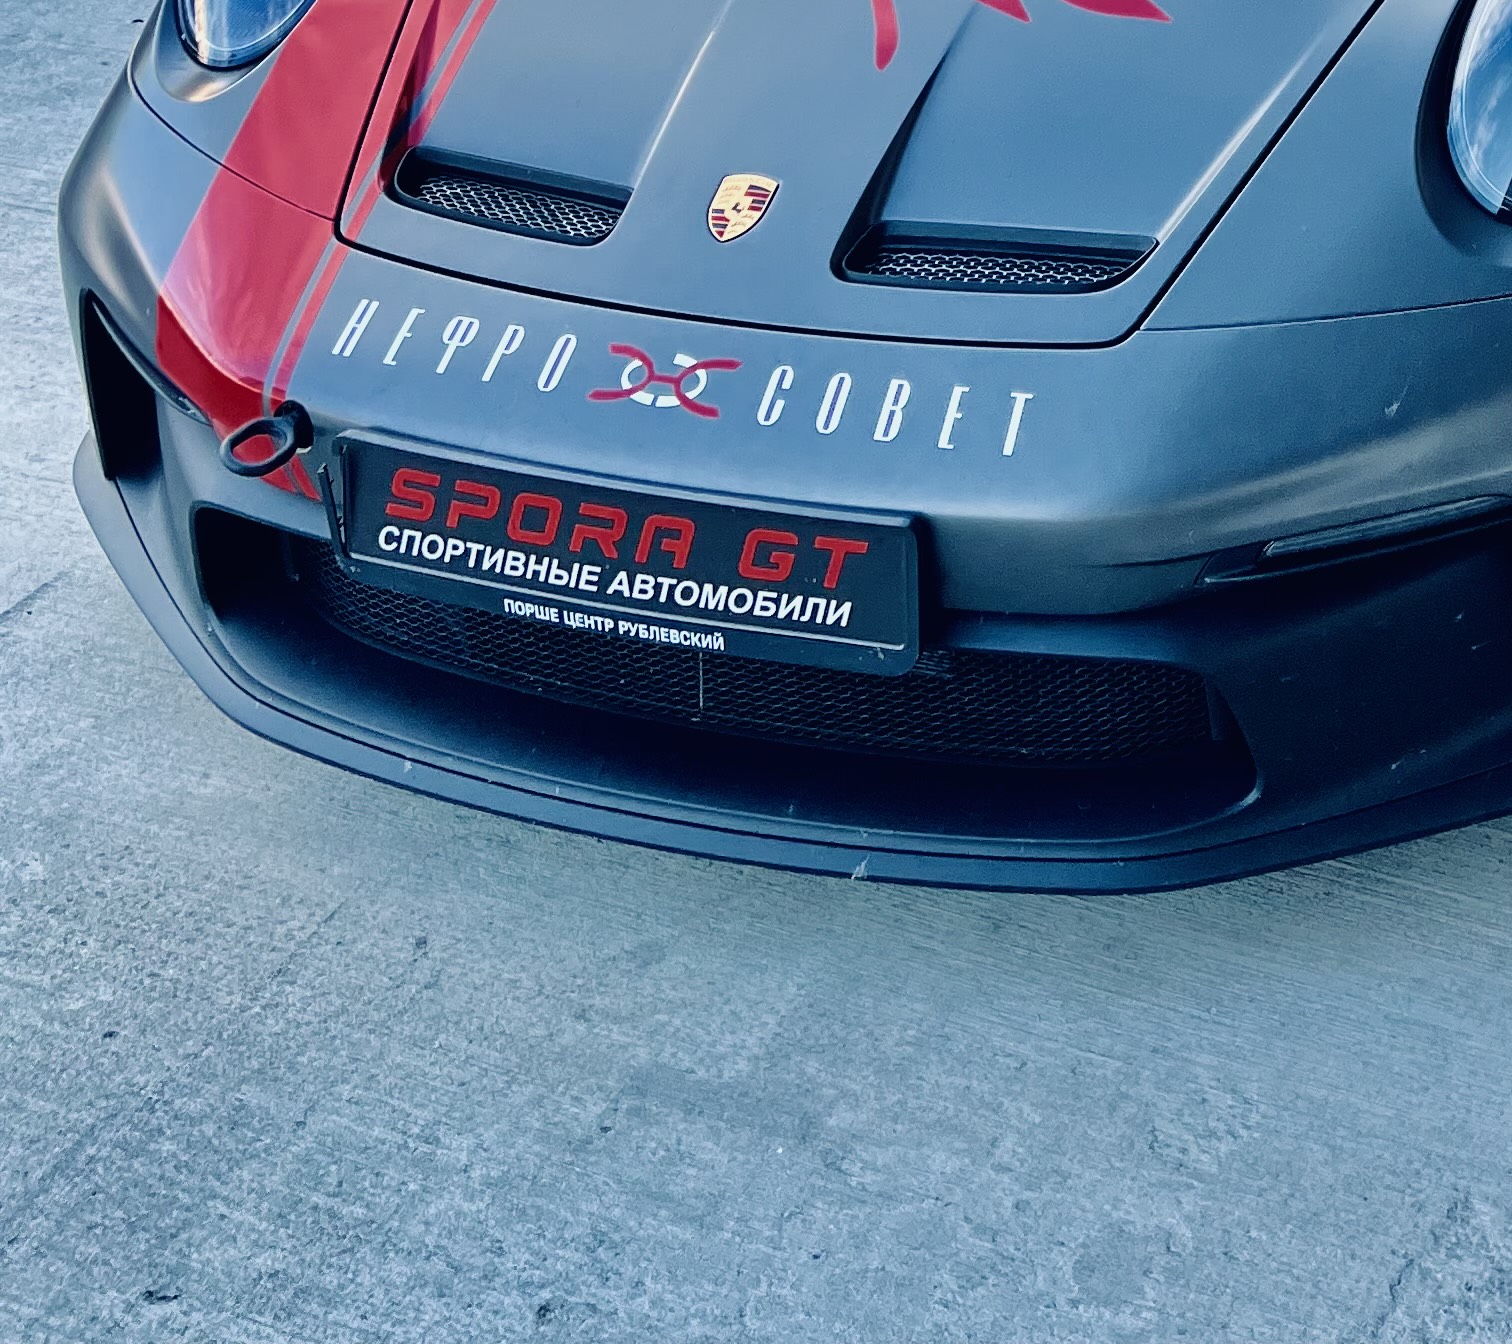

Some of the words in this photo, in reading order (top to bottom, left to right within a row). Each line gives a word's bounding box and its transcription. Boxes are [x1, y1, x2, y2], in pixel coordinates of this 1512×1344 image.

[331, 298, 578, 393] НЕФРО
[756, 365, 1035, 457] СОВЕТ
[378, 524, 603, 593] СПОРТИВНЫЕ
[606, 569, 852, 628] АВТОМОБИЛИ
[385, 467, 697, 570] SPORA
[737, 527, 869, 590] GT
[503, 598, 560, 624] ПОРШЕ
[562, 611, 614, 633] ЦЕНТР
[617, 619, 726, 652] РУБЛЕВСКИЙ
